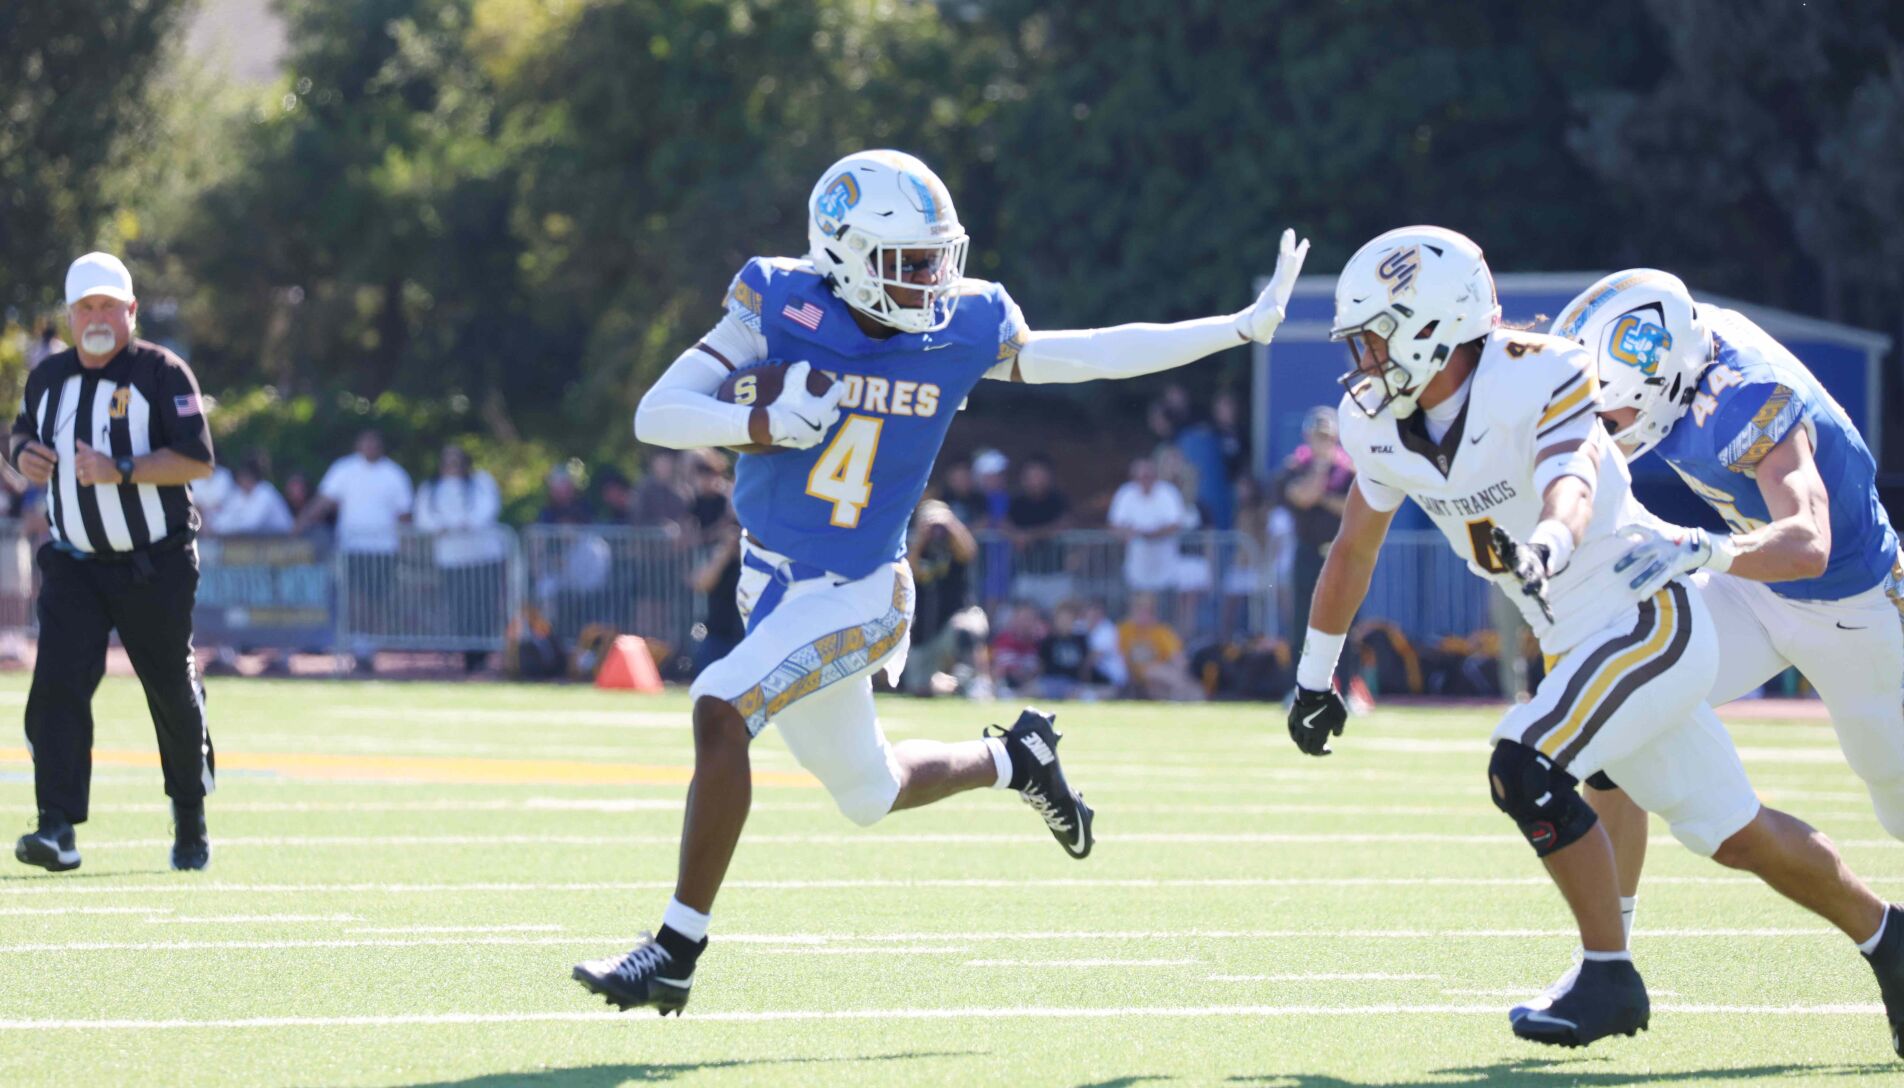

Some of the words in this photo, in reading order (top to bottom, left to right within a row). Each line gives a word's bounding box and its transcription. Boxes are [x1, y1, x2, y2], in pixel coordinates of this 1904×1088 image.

[734, 374, 757, 406] S
[820, 369, 941, 418] DRES
[1690, 364, 1744, 429] 44
[804, 413, 884, 529] 4
[1452, 480, 1517, 516] FRANCIS
[1020, 731, 1055, 766] NIKE
